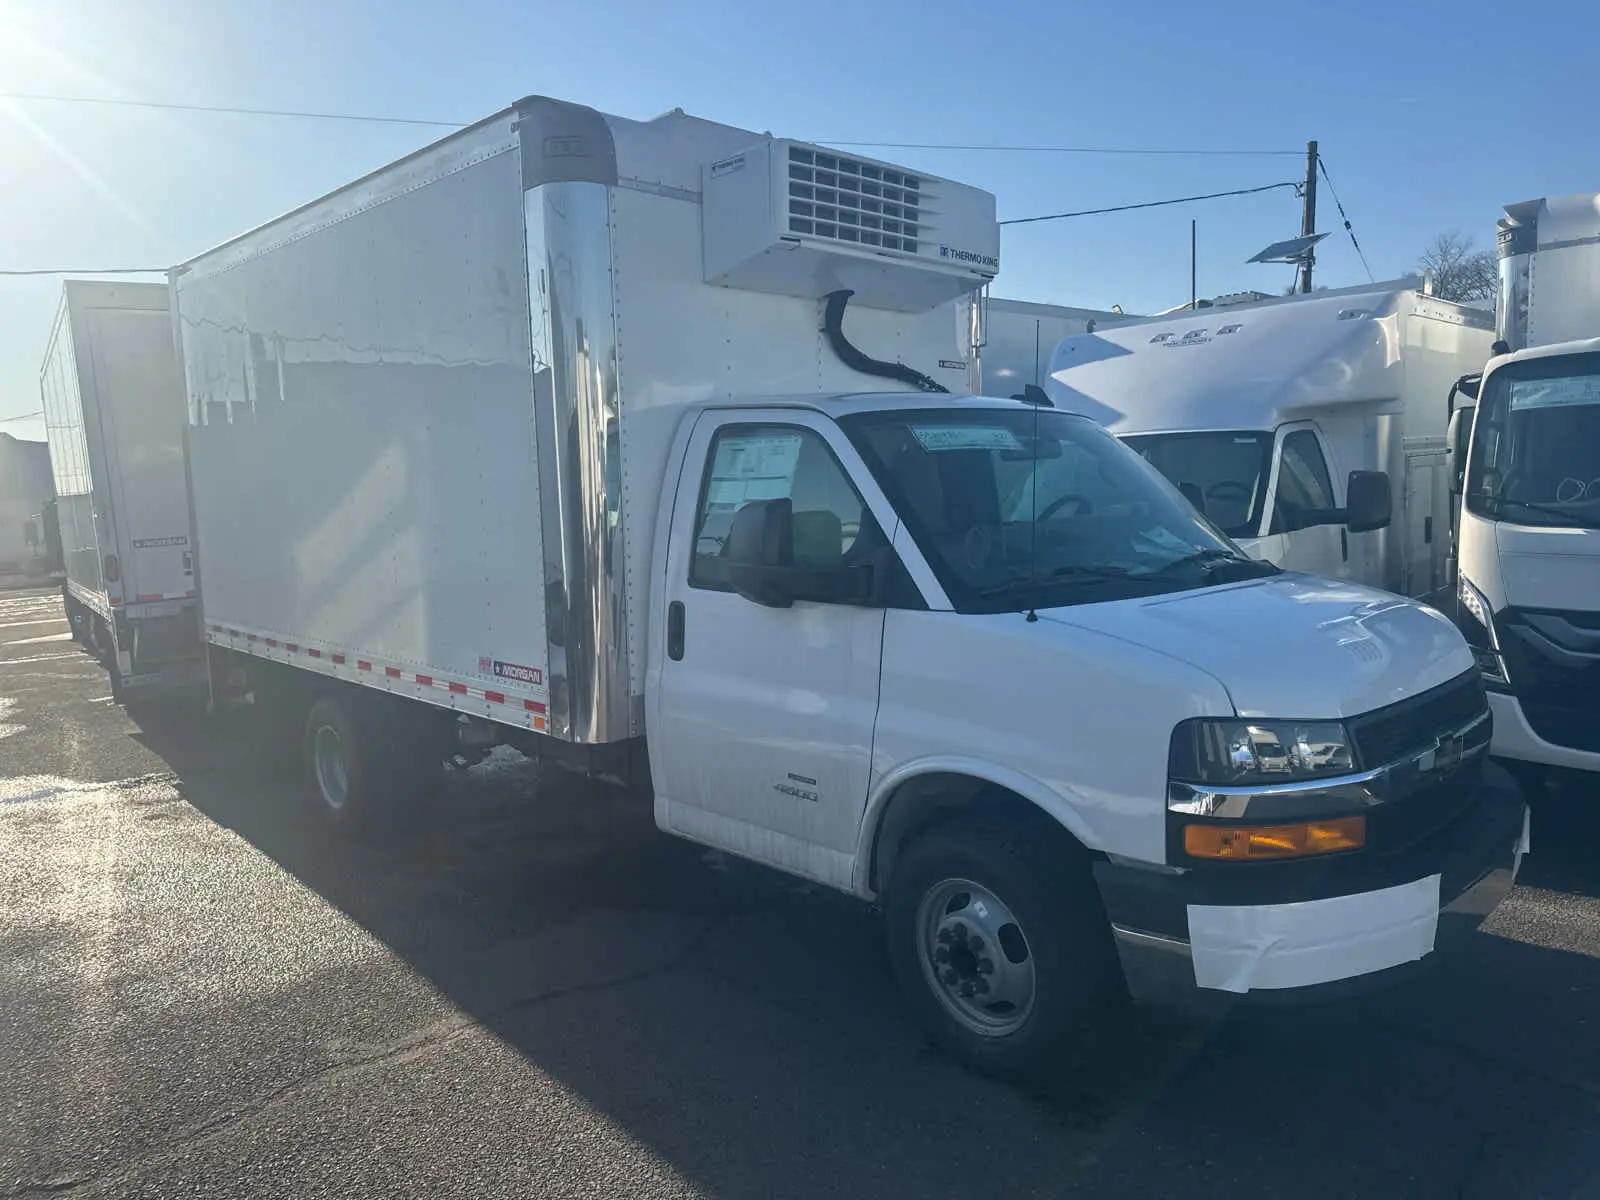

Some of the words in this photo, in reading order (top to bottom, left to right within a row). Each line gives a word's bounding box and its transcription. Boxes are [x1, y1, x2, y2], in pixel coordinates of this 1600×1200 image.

[950, 248, 981, 265] THERMO
[982, 255, 998, 267] KING
[502, 664, 540, 682] MORGAN
